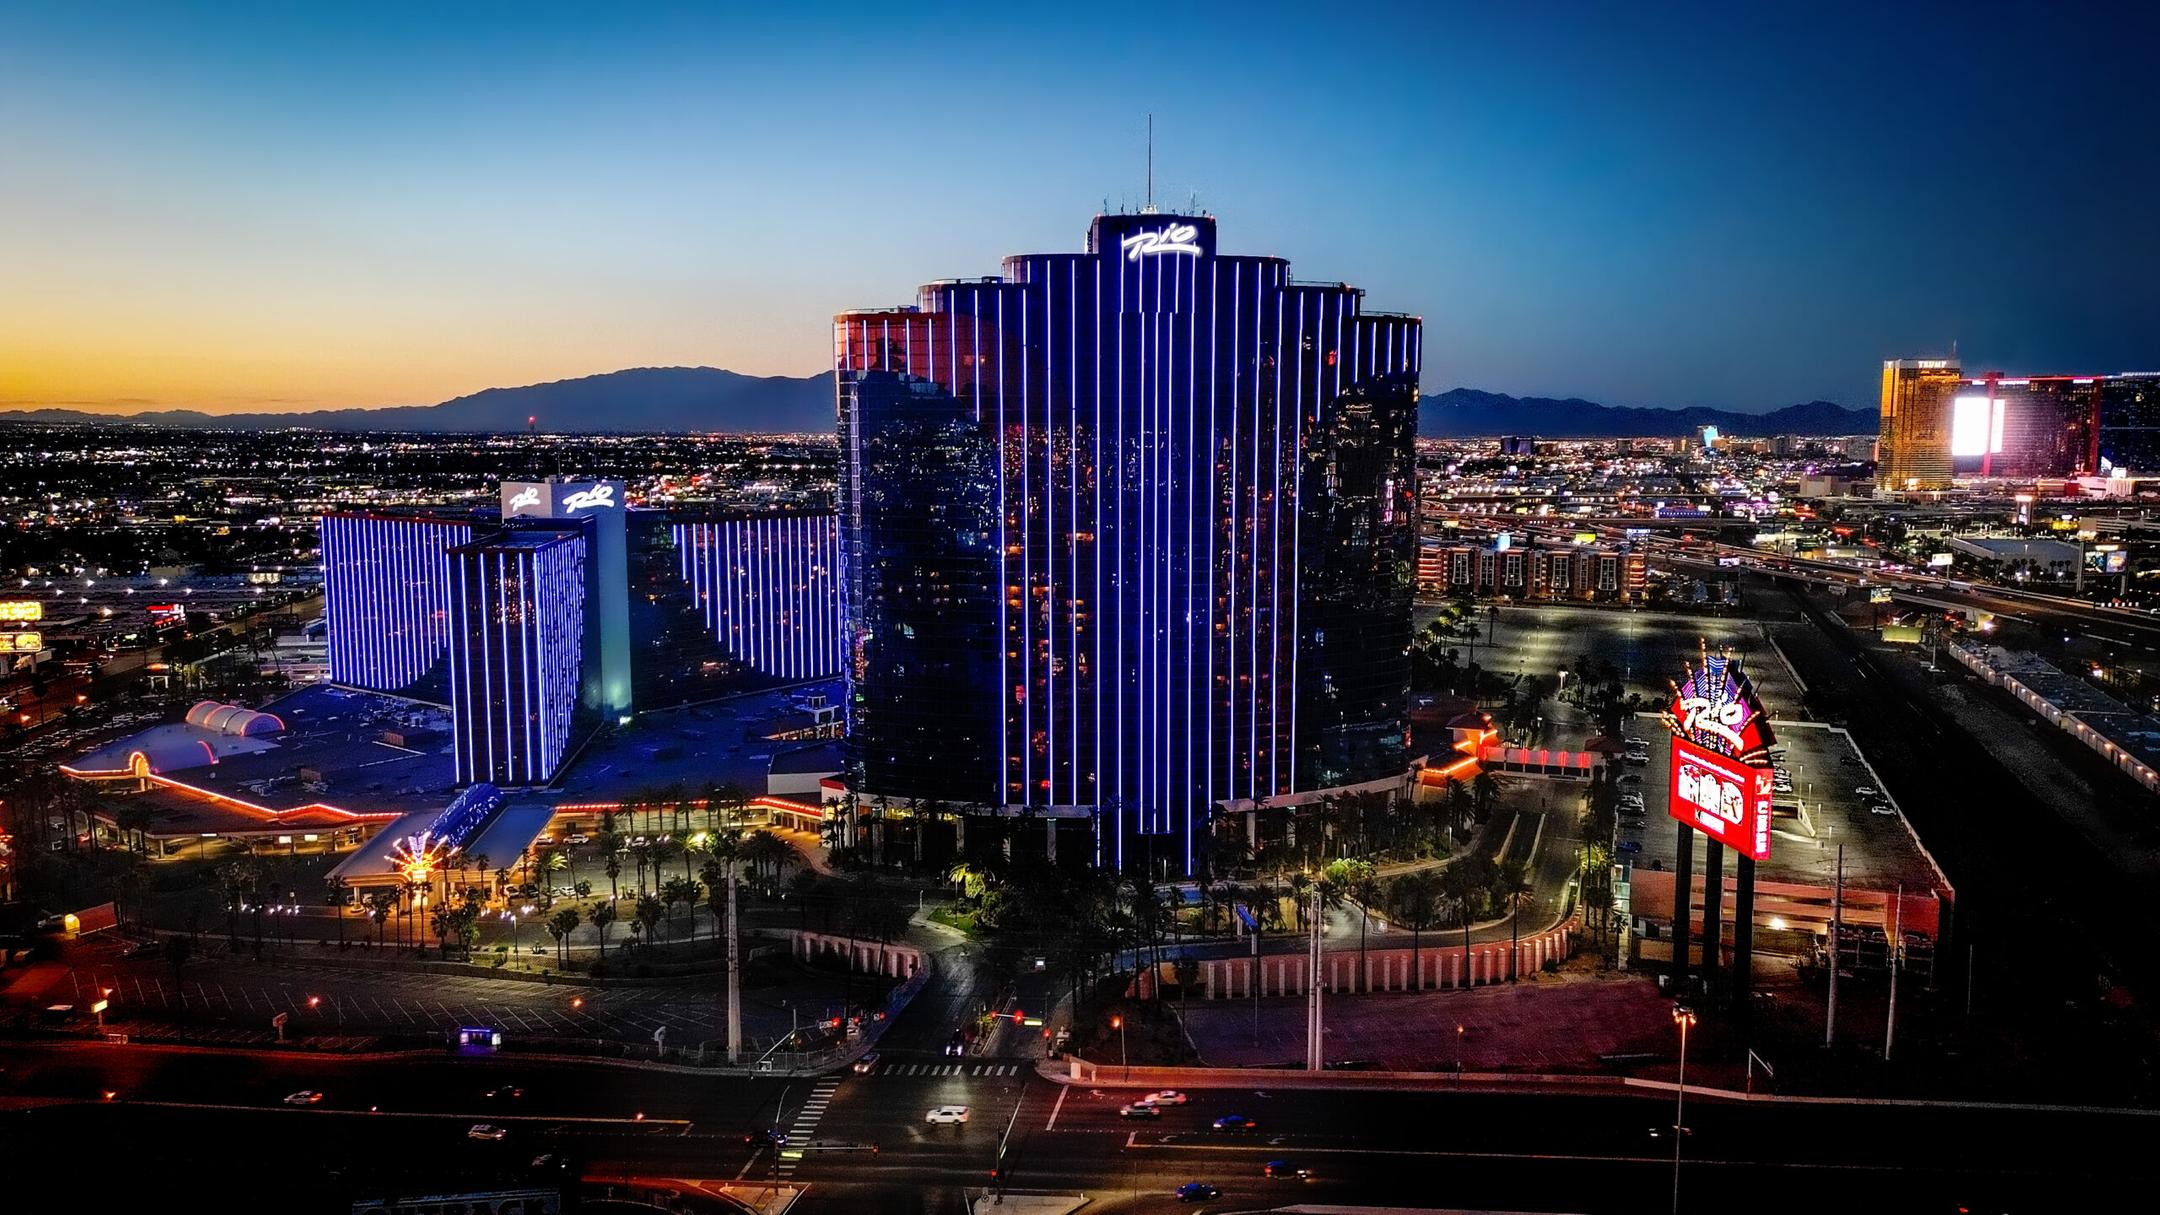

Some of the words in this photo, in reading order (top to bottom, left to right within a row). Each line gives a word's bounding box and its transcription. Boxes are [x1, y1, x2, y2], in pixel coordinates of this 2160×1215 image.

[1121, 223, 1203, 261] Rio
[509, 486, 541, 512] Rio
[562, 484, 615, 514] Rio
[1680, 692, 1744, 751] Rio
